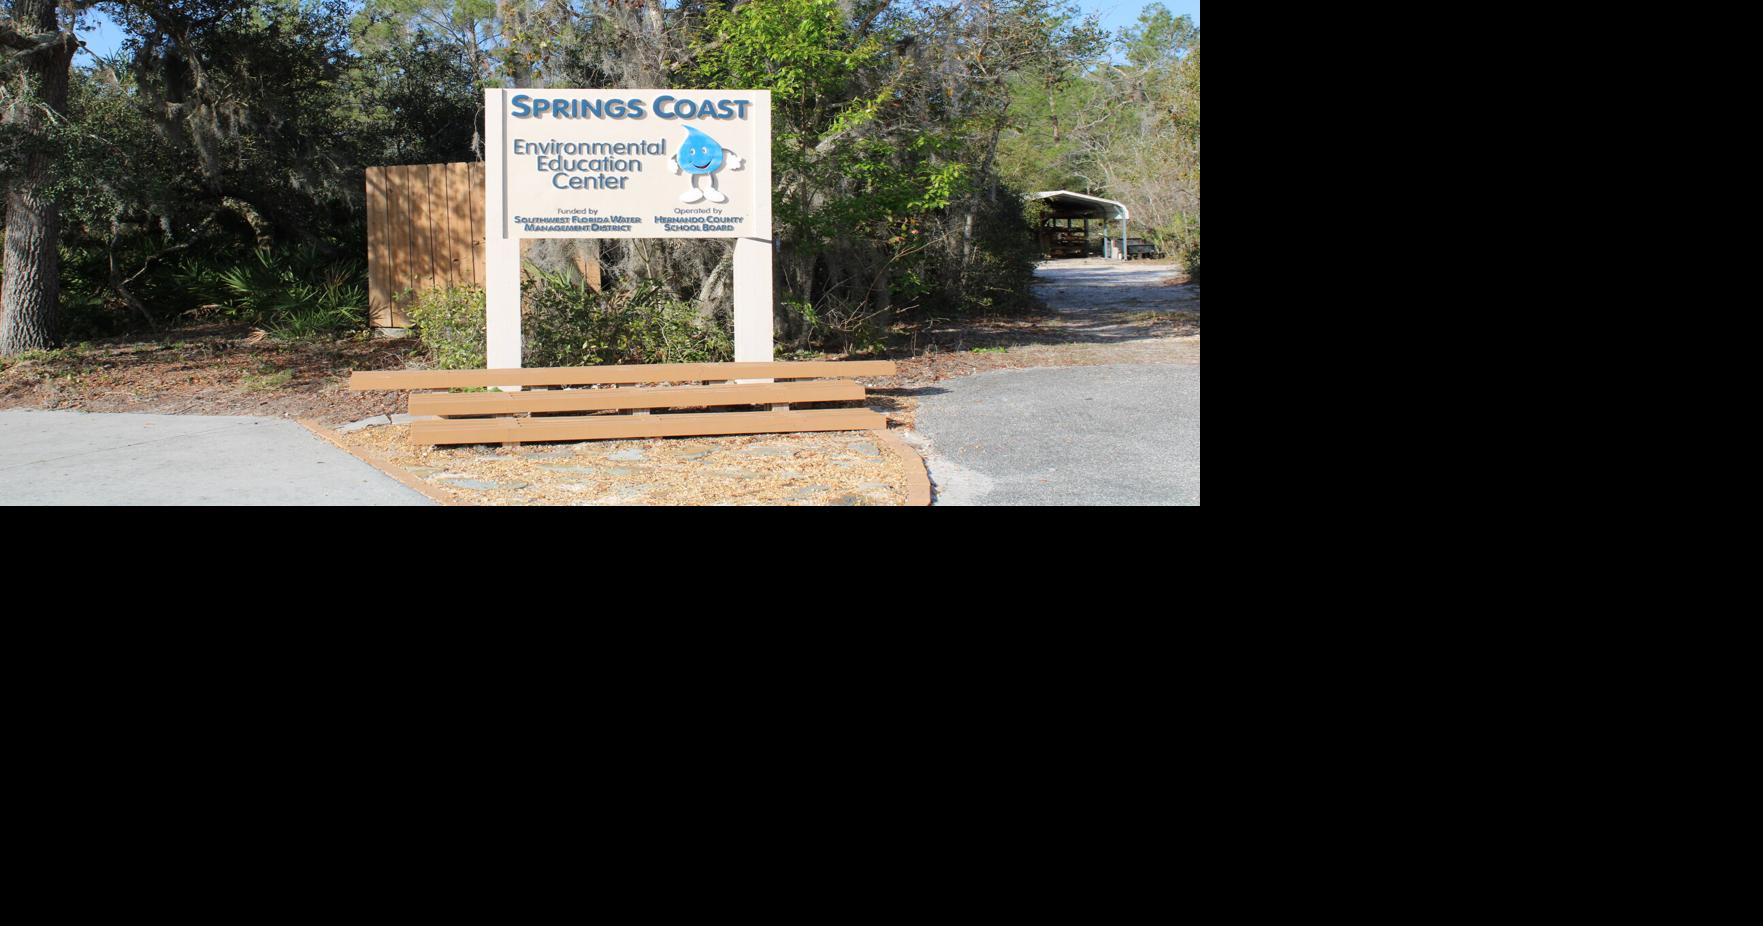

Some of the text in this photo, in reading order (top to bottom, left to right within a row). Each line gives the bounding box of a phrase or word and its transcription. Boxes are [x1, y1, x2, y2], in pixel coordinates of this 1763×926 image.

[511, 94, 750, 120] SPRINGS COAST
[513, 138, 666, 155] Environmental
[537, 155, 643, 172] Education
[552, 172, 629, 190] Center
[588, 208, 598, 216] by
[514, 216, 642, 224] SOUTHWEST FLORIDA WATER
[654, 216, 744, 224] HERNANDO COUNTY
[524, 224, 632, 232] MANAGEMENT DISTRICT
[664, 224, 735, 232] SCHOOL BOARD
